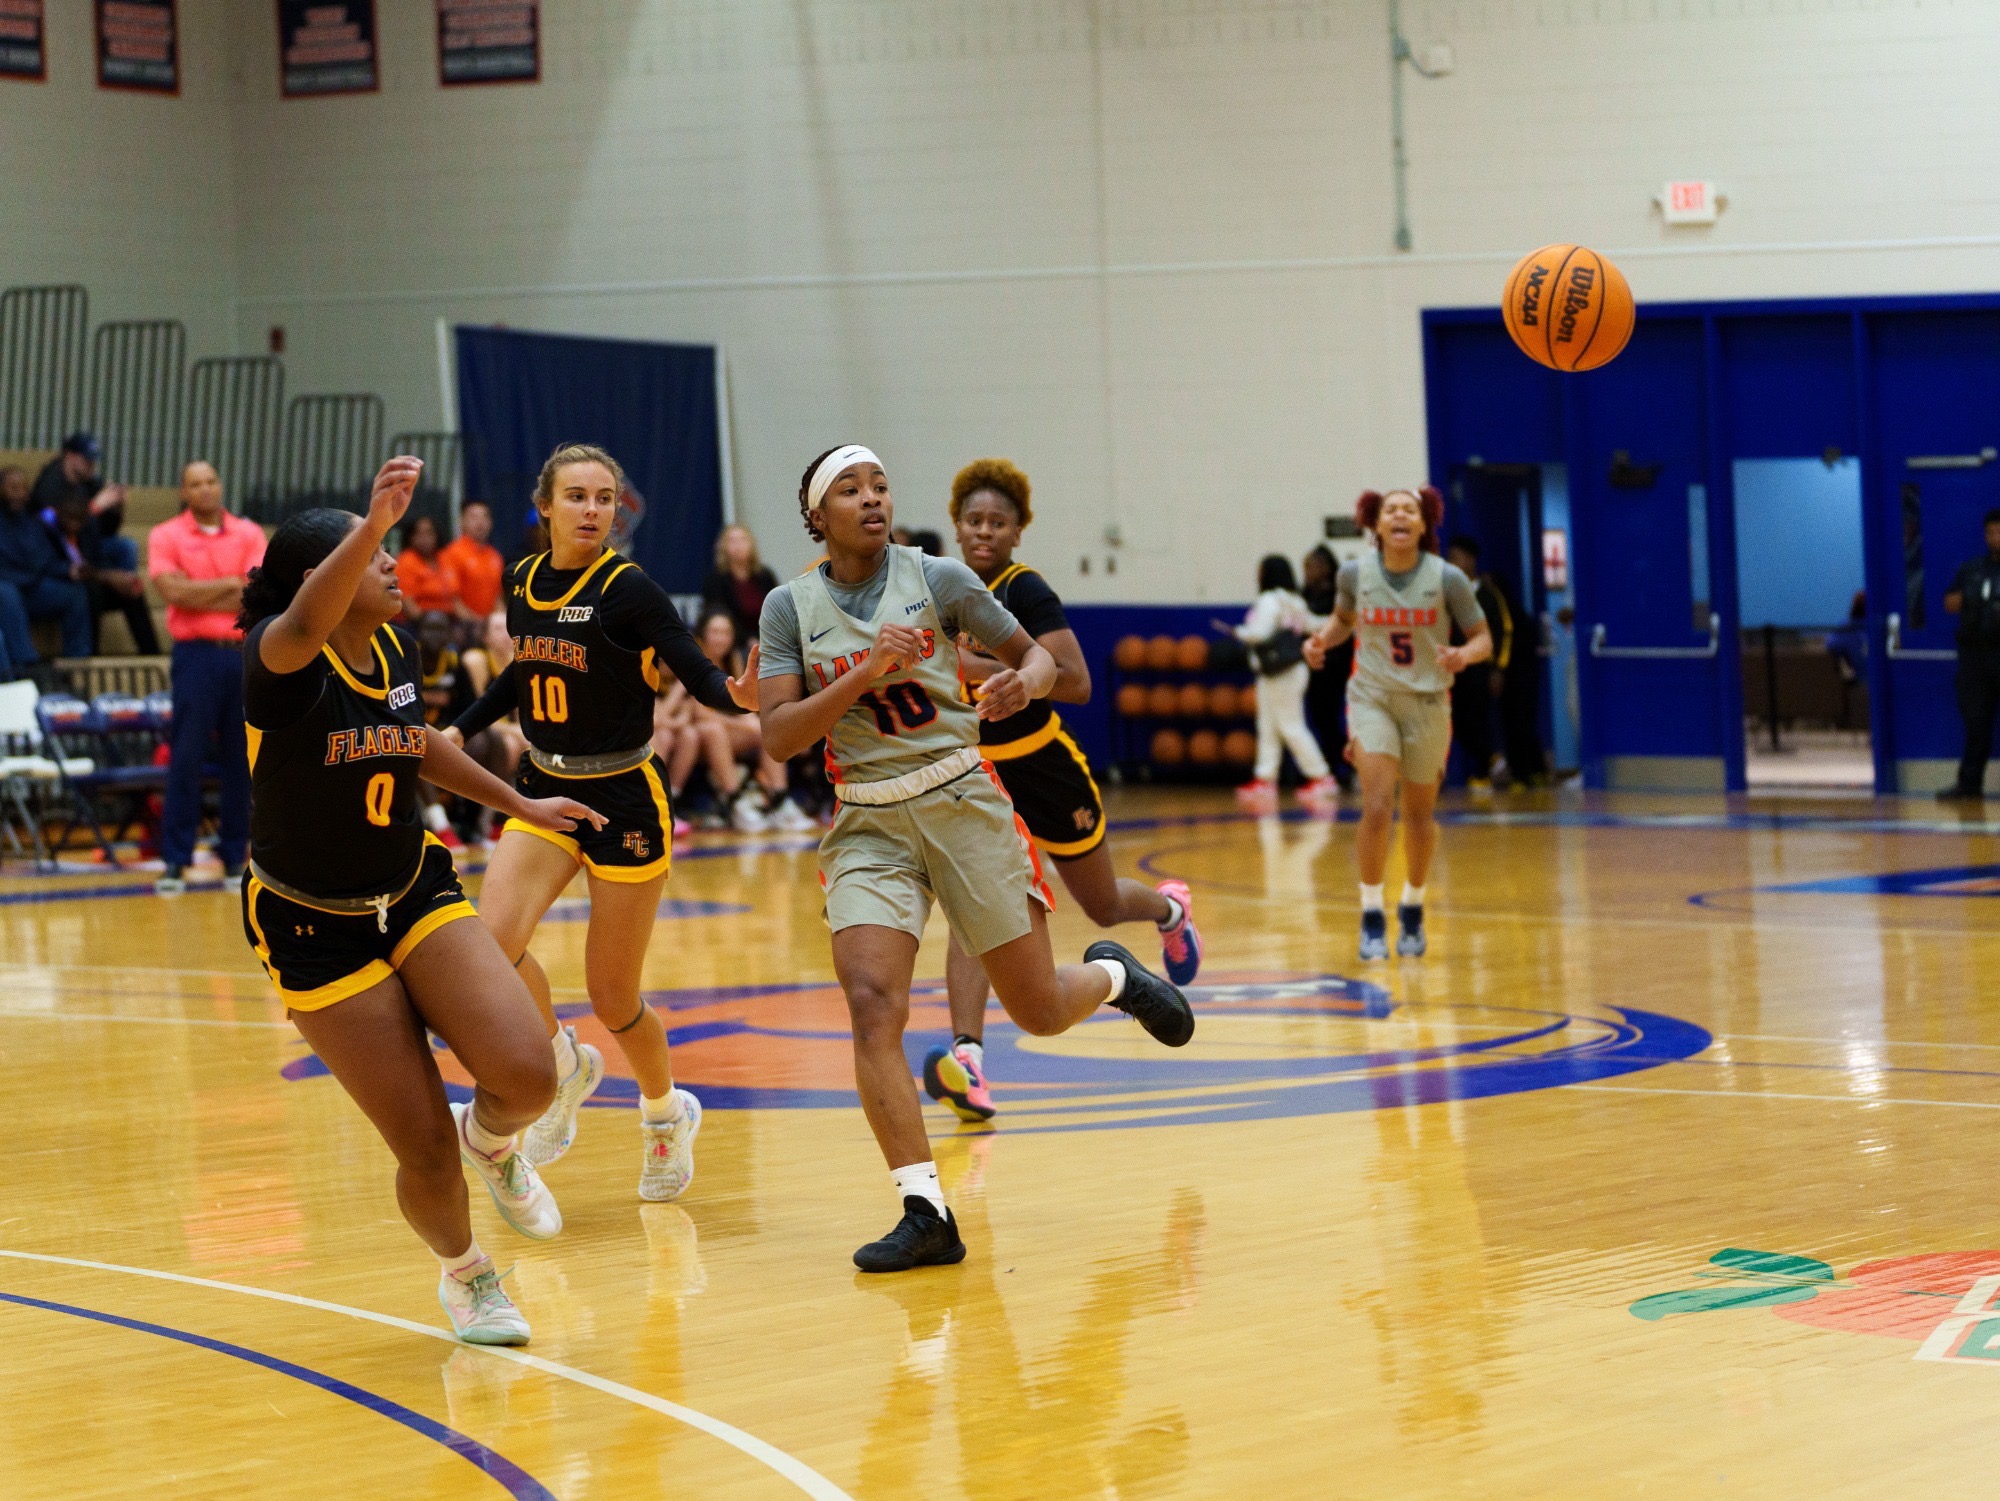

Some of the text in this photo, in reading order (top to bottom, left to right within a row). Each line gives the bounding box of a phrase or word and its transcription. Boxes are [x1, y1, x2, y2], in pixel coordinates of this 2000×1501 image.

[1671, 182, 1705, 211] EXIT
[1556, 265, 1595, 343] Wilson
[557, 606, 593, 622] PBC
[904, 597, 930, 616] PBC
[1362, 607, 1438, 627] LAKERS
[513, 635, 588, 673] LAGLER
[811, 628, 936, 690] LAKS
[1389, 631, 1414, 668] 5
[388, 682, 417, 710] PBC
[529, 673, 569, 723] 10
[857, 678, 939, 737] 10
[365, 772, 395, 827] 0
[623, 831, 649, 857] FC
